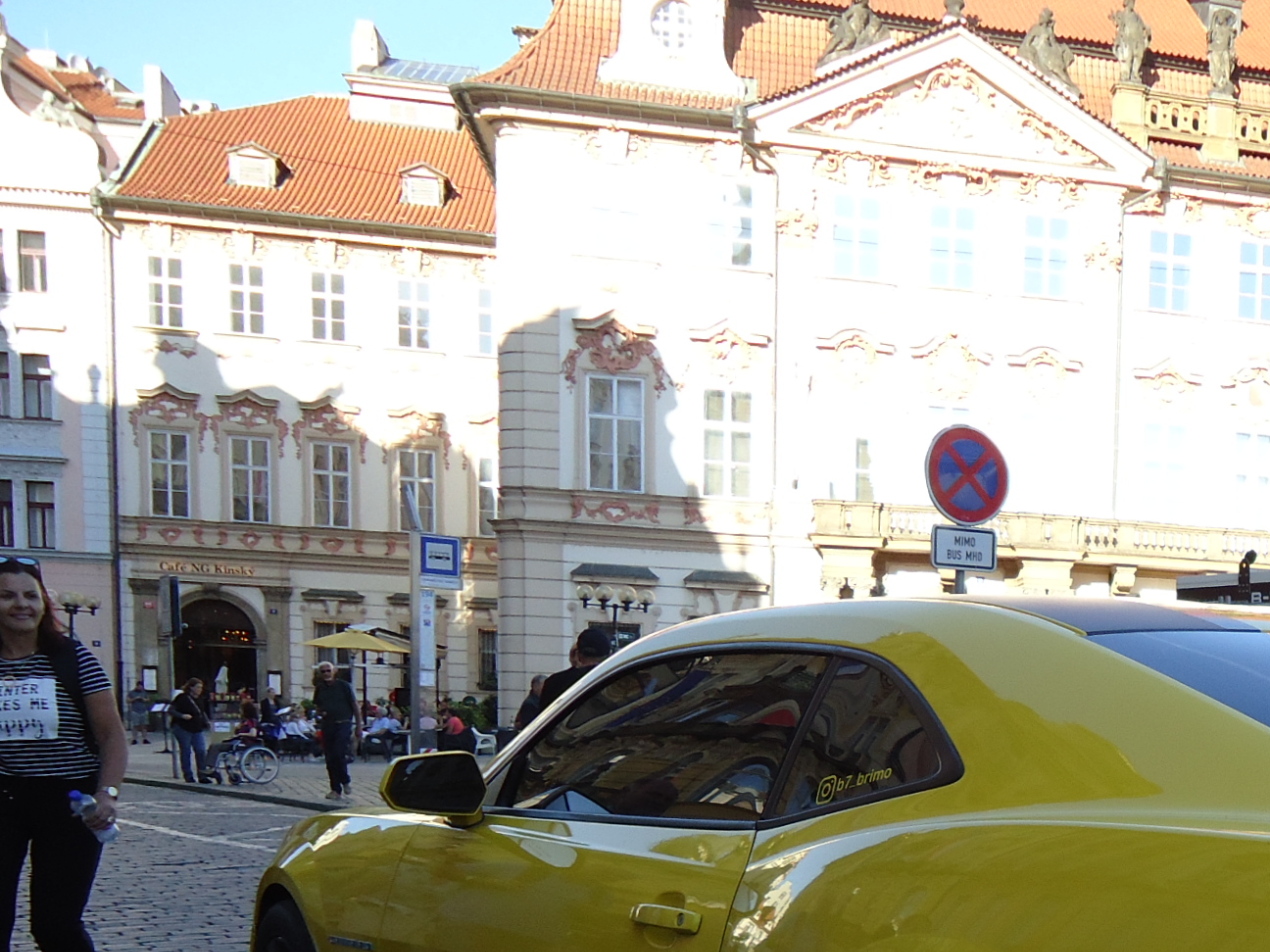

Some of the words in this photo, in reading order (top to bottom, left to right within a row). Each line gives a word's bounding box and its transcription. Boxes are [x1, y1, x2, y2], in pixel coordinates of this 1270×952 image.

[954, 536, 976, 547] MIMO
[947, 549, 962, 560] BUS
[965, 550, 982, 562] MHD
[159, 561, 187, 573] Café
[191, 563, 210, 574] NG
[214, 563, 256, 576] Kinský
[30, 697, 49, 710] ME
[836, 767, 892, 791] b7_brimo
